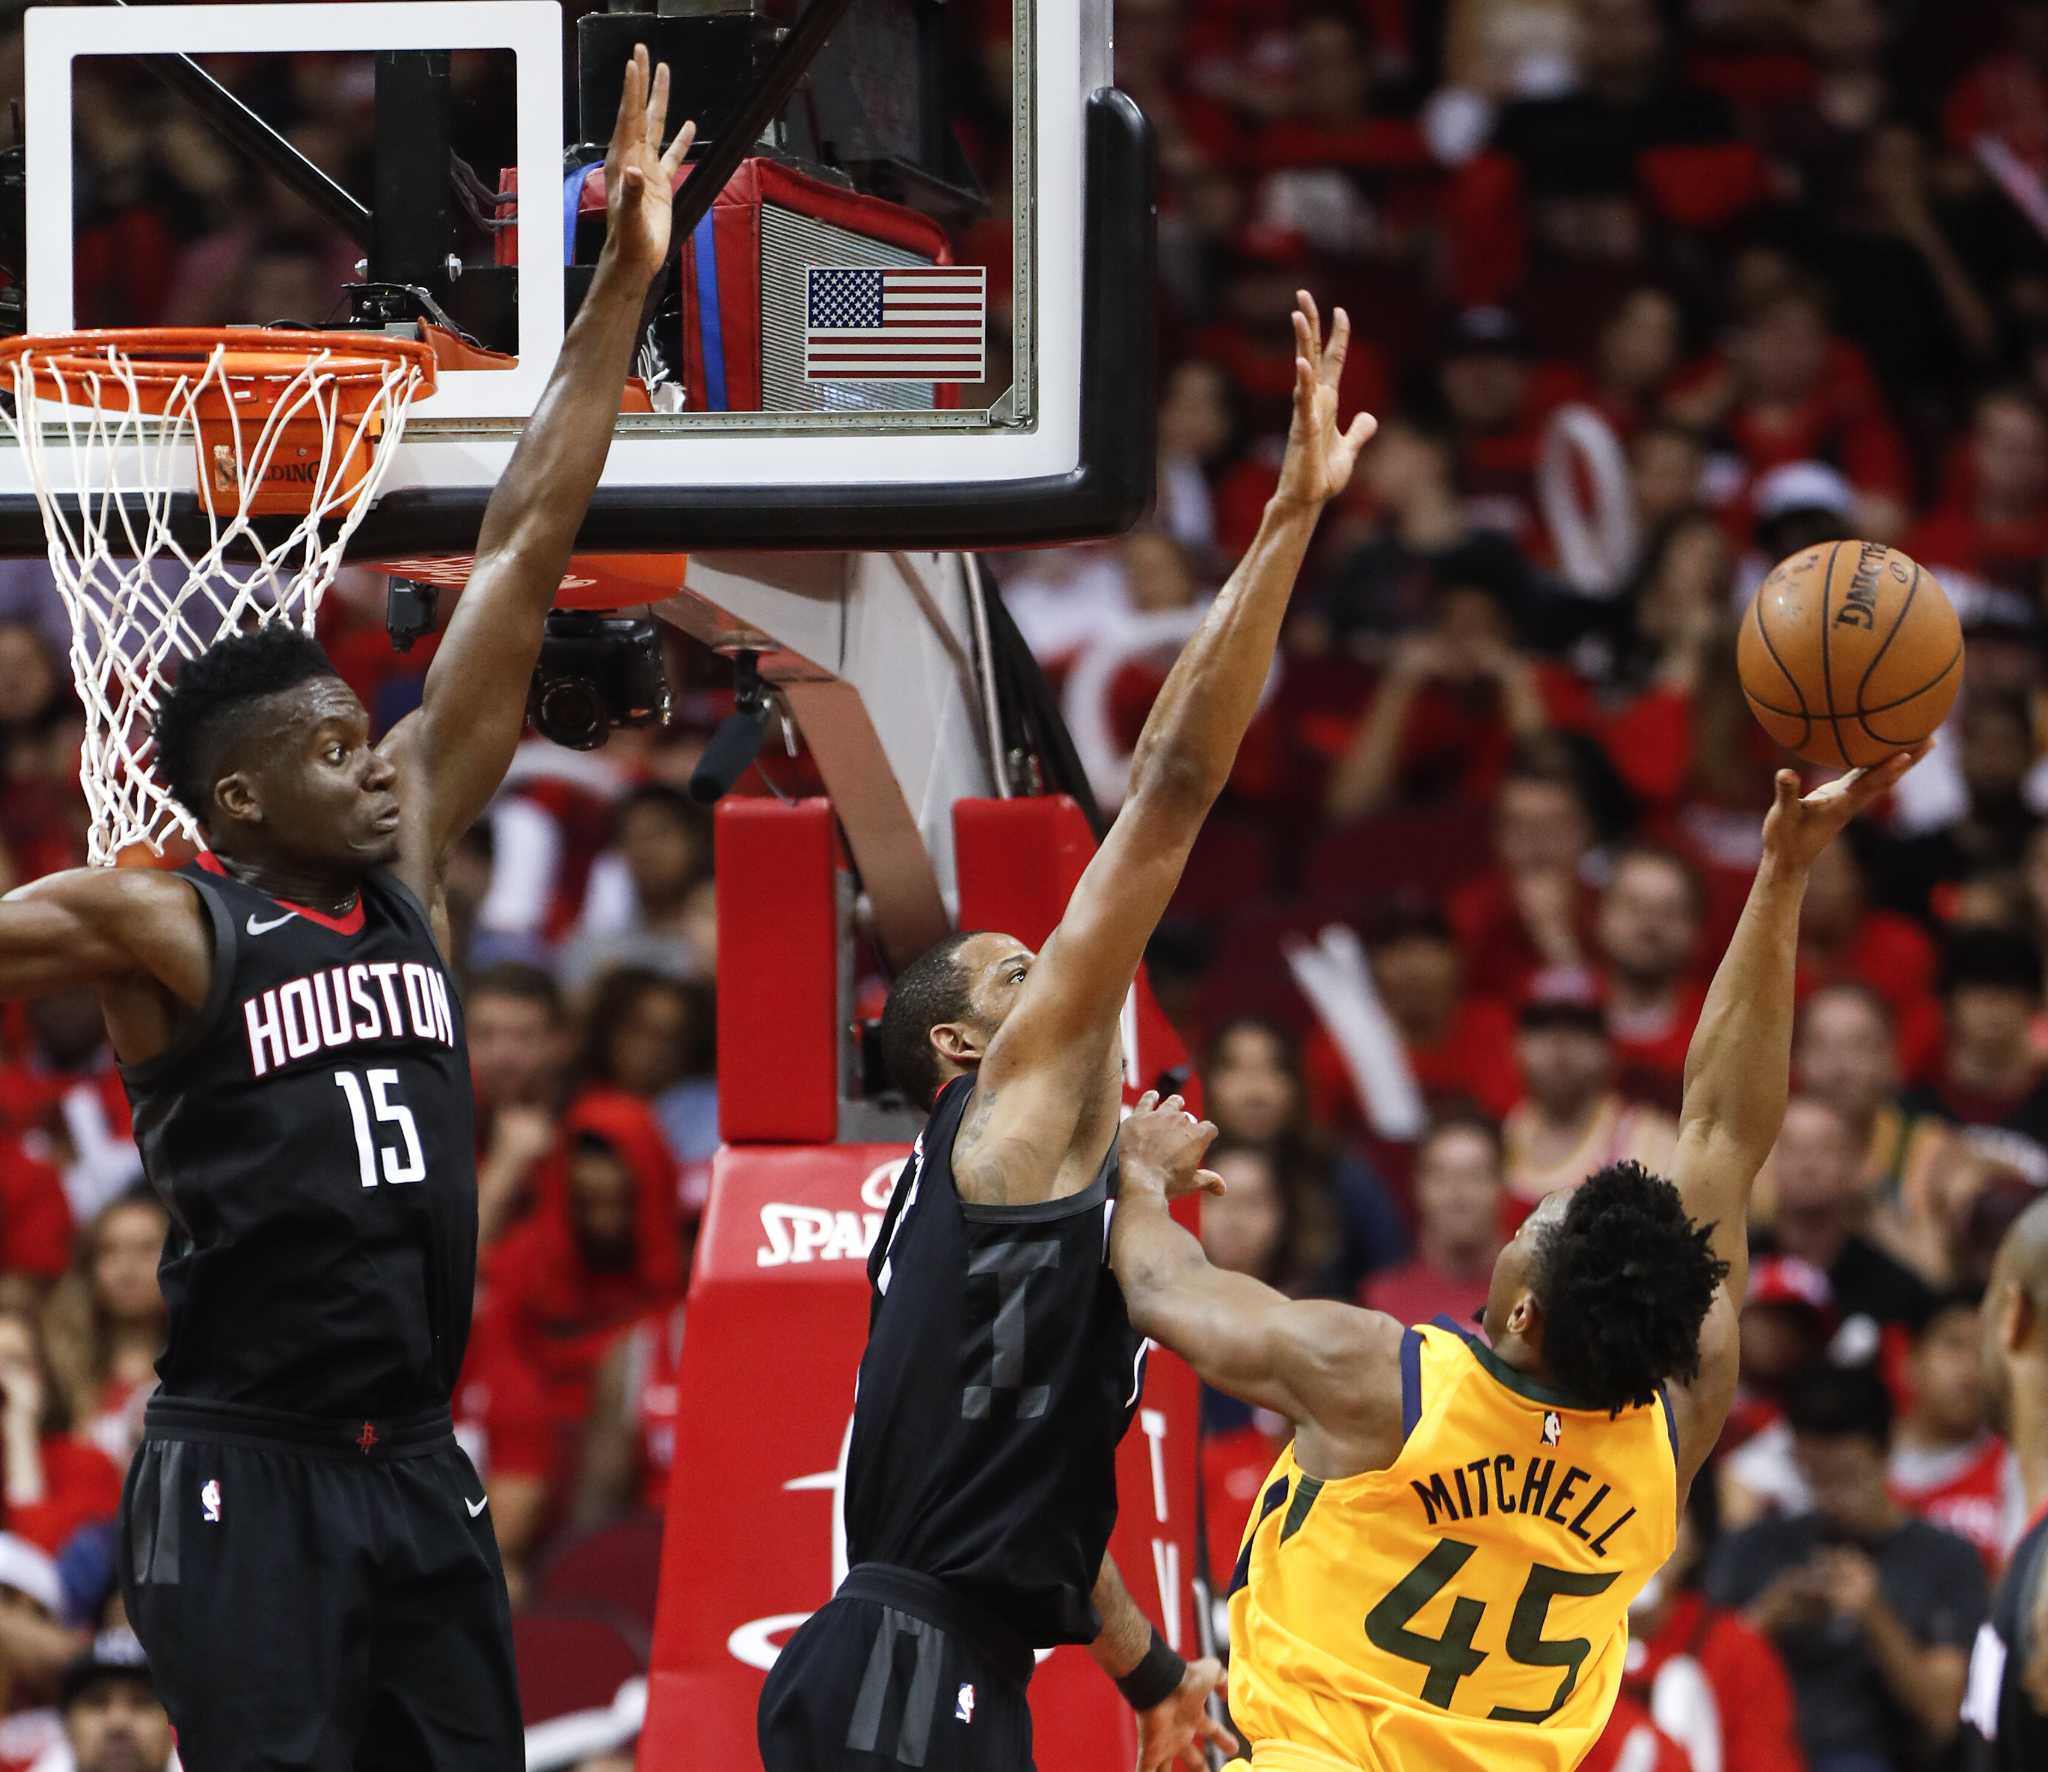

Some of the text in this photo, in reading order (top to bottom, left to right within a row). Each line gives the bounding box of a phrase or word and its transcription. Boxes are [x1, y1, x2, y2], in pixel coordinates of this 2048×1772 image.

[244, 962, 453, 1078] HOUSTON
[334, 1068, 426, 1188] 15
[1410, 1453, 1637, 1558] MITCHELL
[1364, 1537, 1623, 1725] 45
